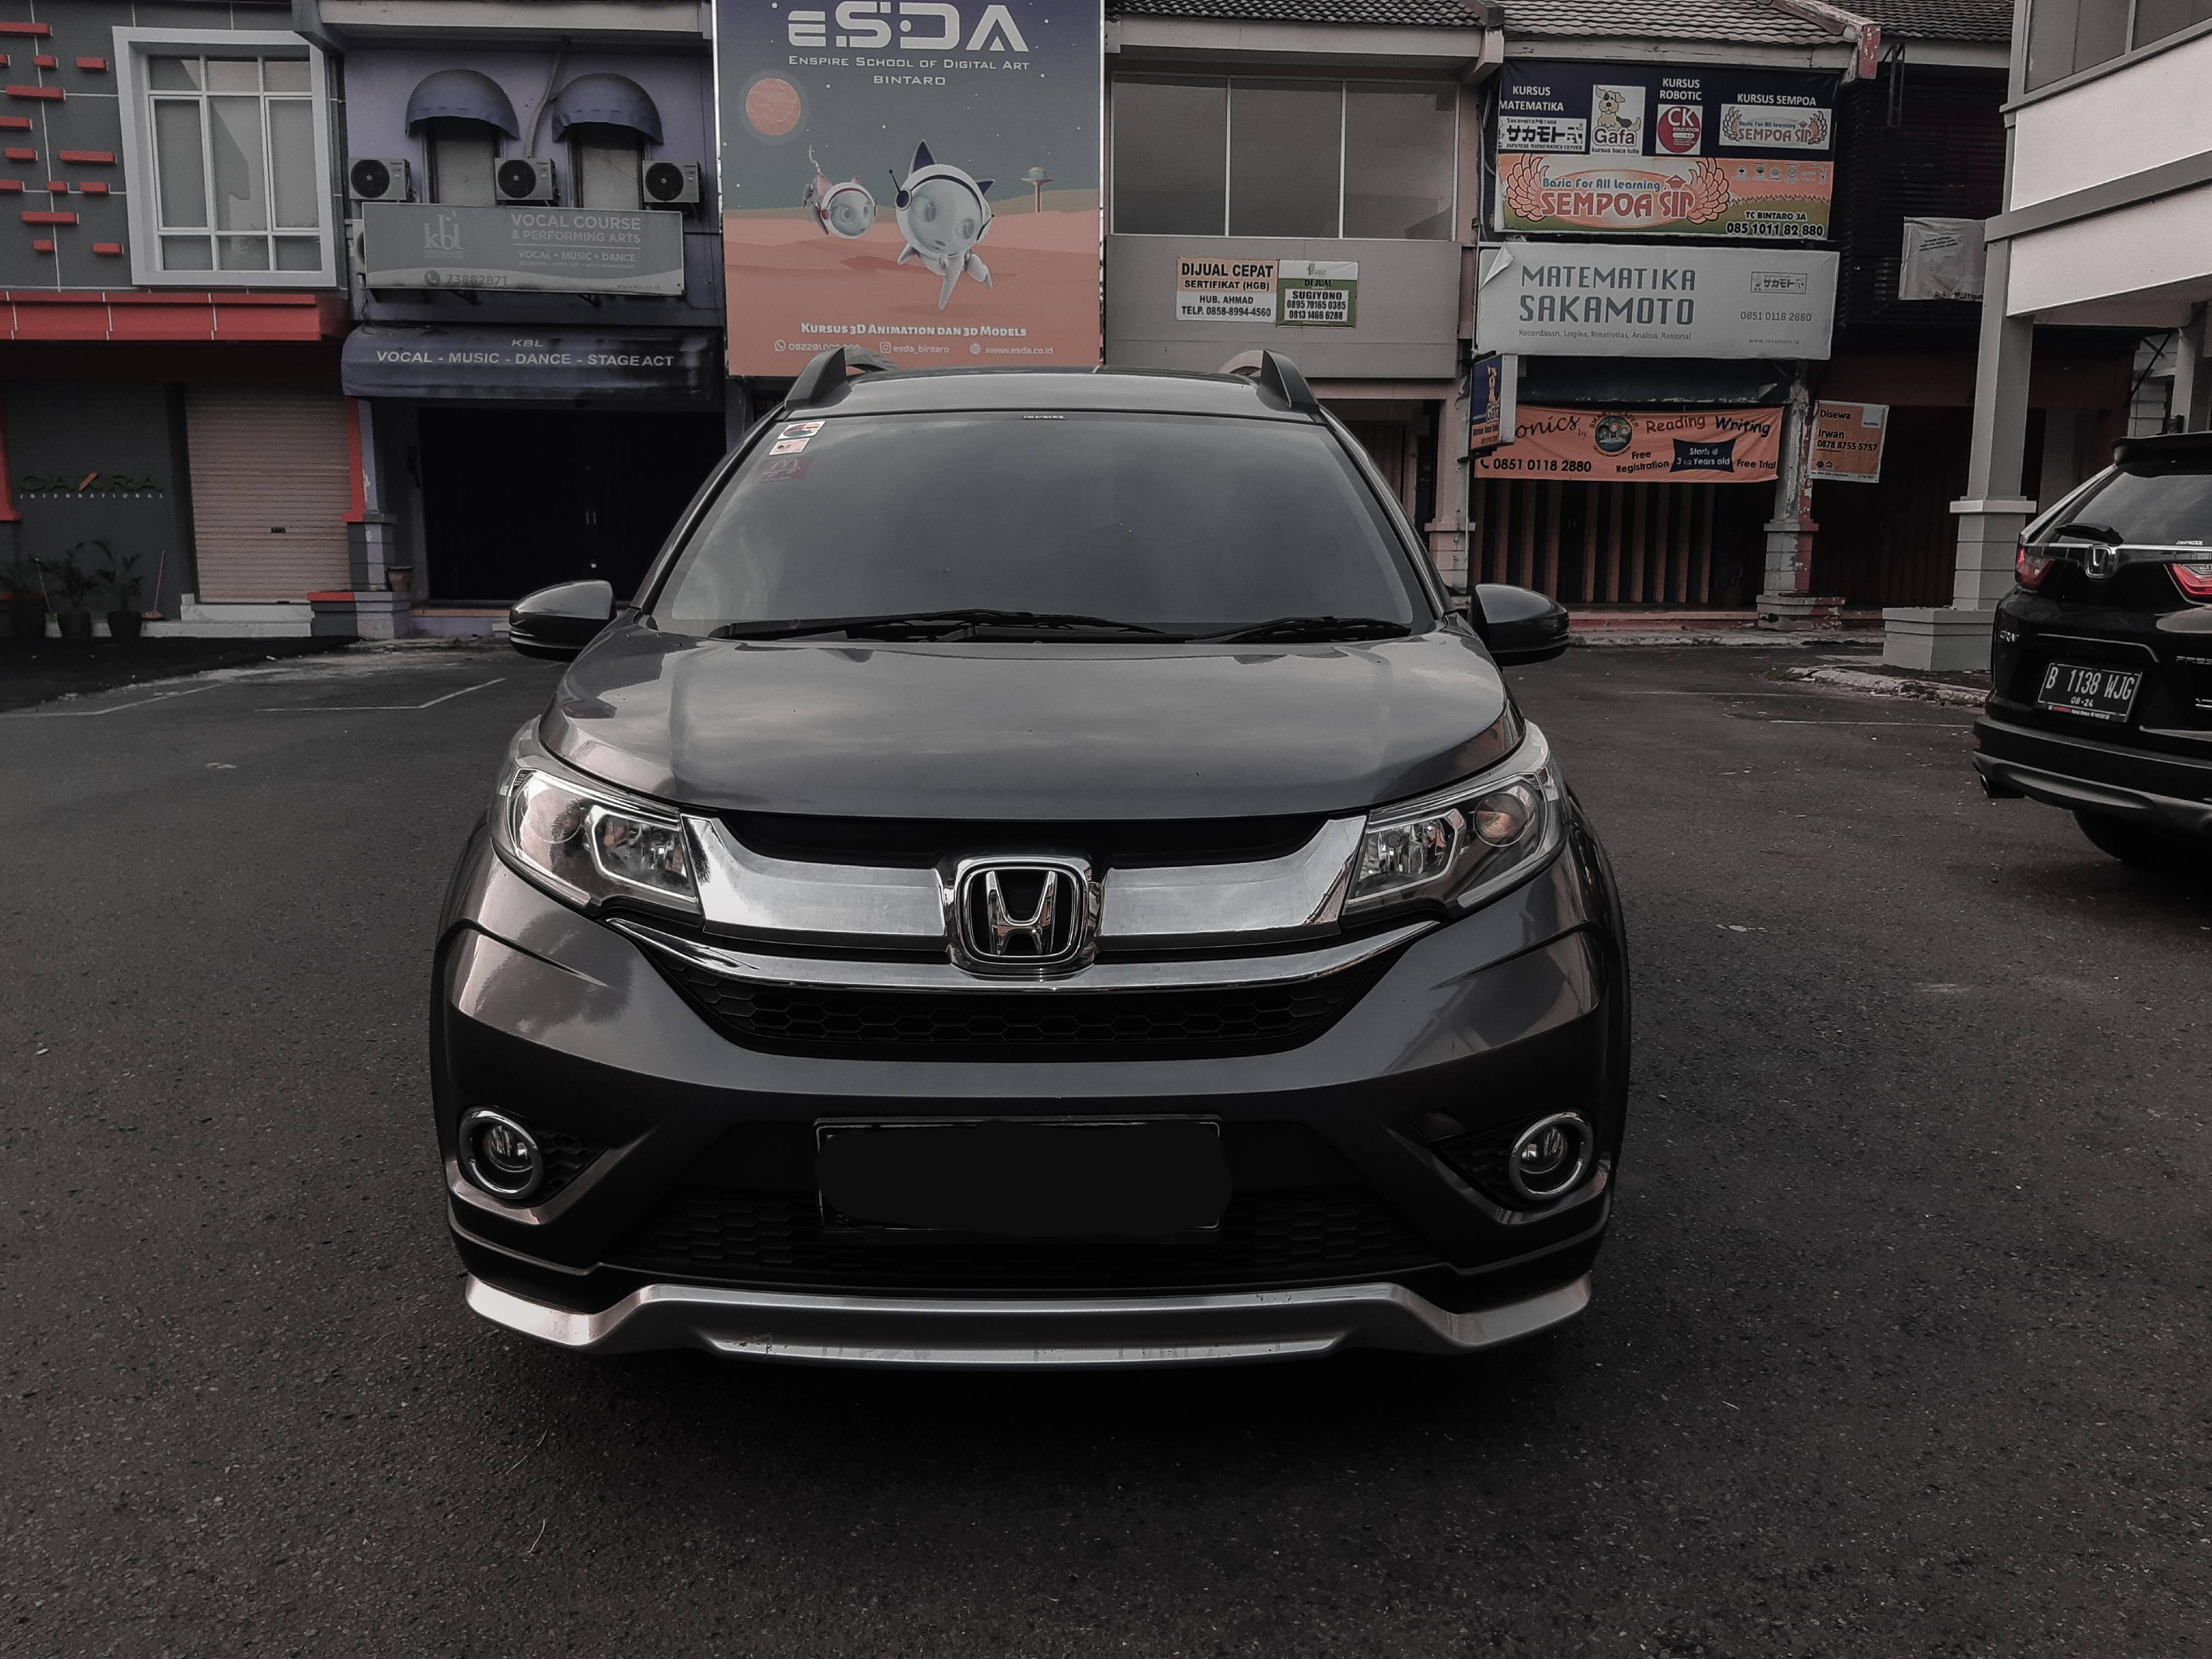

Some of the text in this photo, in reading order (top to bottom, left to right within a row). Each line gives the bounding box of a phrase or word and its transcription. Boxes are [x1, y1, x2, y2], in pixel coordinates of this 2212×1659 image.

[873, 75, 946, 85] BINTARO
[1663, 78, 1700, 89] KURSUS
[1512, 85, 1551, 96] KURSUS
[1660, 90, 1702, 101] ROBOTIC
[1737, 93, 1816, 106] KURSUS SEMPOA
[1499, 100, 1564, 112] MATEMATIKA
[1668, 108, 1694, 126] CK
[1594, 128, 1635, 144] Gafa
[1737, 128, 1792, 143] SEMPOA
[1542, 177, 1572, 188] Basic
[1575, 178, 1594, 188] For
[1596, 178, 1610, 189] All
[1541, 191, 1695, 218] SEMPOA SIP
[1745, 211, 1807, 221] TC BINTARO 3A
[511, 214, 641, 231] VOCAL COURSE
[1727, 222, 1824, 237] 085 1011 82 880
[511, 230, 641, 244] & PERFORMING ARTS
[518, 250, 636, 262] VOCAL MUSIC DANCE
[1182, 262, 1273, 278] DIJUAL CEPAT
[1521, 265, 1696, 291] MATEMATIKA
[1184, 280, 1270, 291] SERTIFIKAT (HGB)
[1199, 295, 1254, 305] HUB. AHMAD
[1292, 291, 1342, 300] SUGIYONO
[1286, 300, 1305, 309] 0895
[1328, 301, 1346, 310] 0385
[1519, 294, 1694, 325] SAKAMOTO
[1181, 306, 1271, 317] TELP. 0858-8994-4560
[1740, 311, 1812, 322] 0851 0118 2880
[849, 324, 865, 335] 3D
[1518, 329, 1561, 338] Kecerdasan,
[1563, 329, 1588, 339] Logika,
[1631, 331, 1658, 340] Analisa,
[1661, 332, 1691, 340] Rasional
[376, 350, 675, 367] VOCAL MUSIC DANCE STAGE ACT
[1819, 409, 1851, 420] Disewa
[1515, 415, 1581, 439] onics
[1645, 415, 1706, 434] Reading
[1715, 415, 1771, 438] Writing
[1818, 428, 1845, 439] Irwan
[1690, 447, 1710, 455] Starts
[1817, 440, 1878, 451] 0878 8755 5757
[1631, 451, 1651, 460] Free
[1493, 458, 1592, 473] 0851 0118 2880
[1616, 460, 1669, 474] Registration
[1736, 458, 1777, 469] Free Trial
[2045, 666, 2059, 689] B
[2067, 669, 2101, 695] 1138
